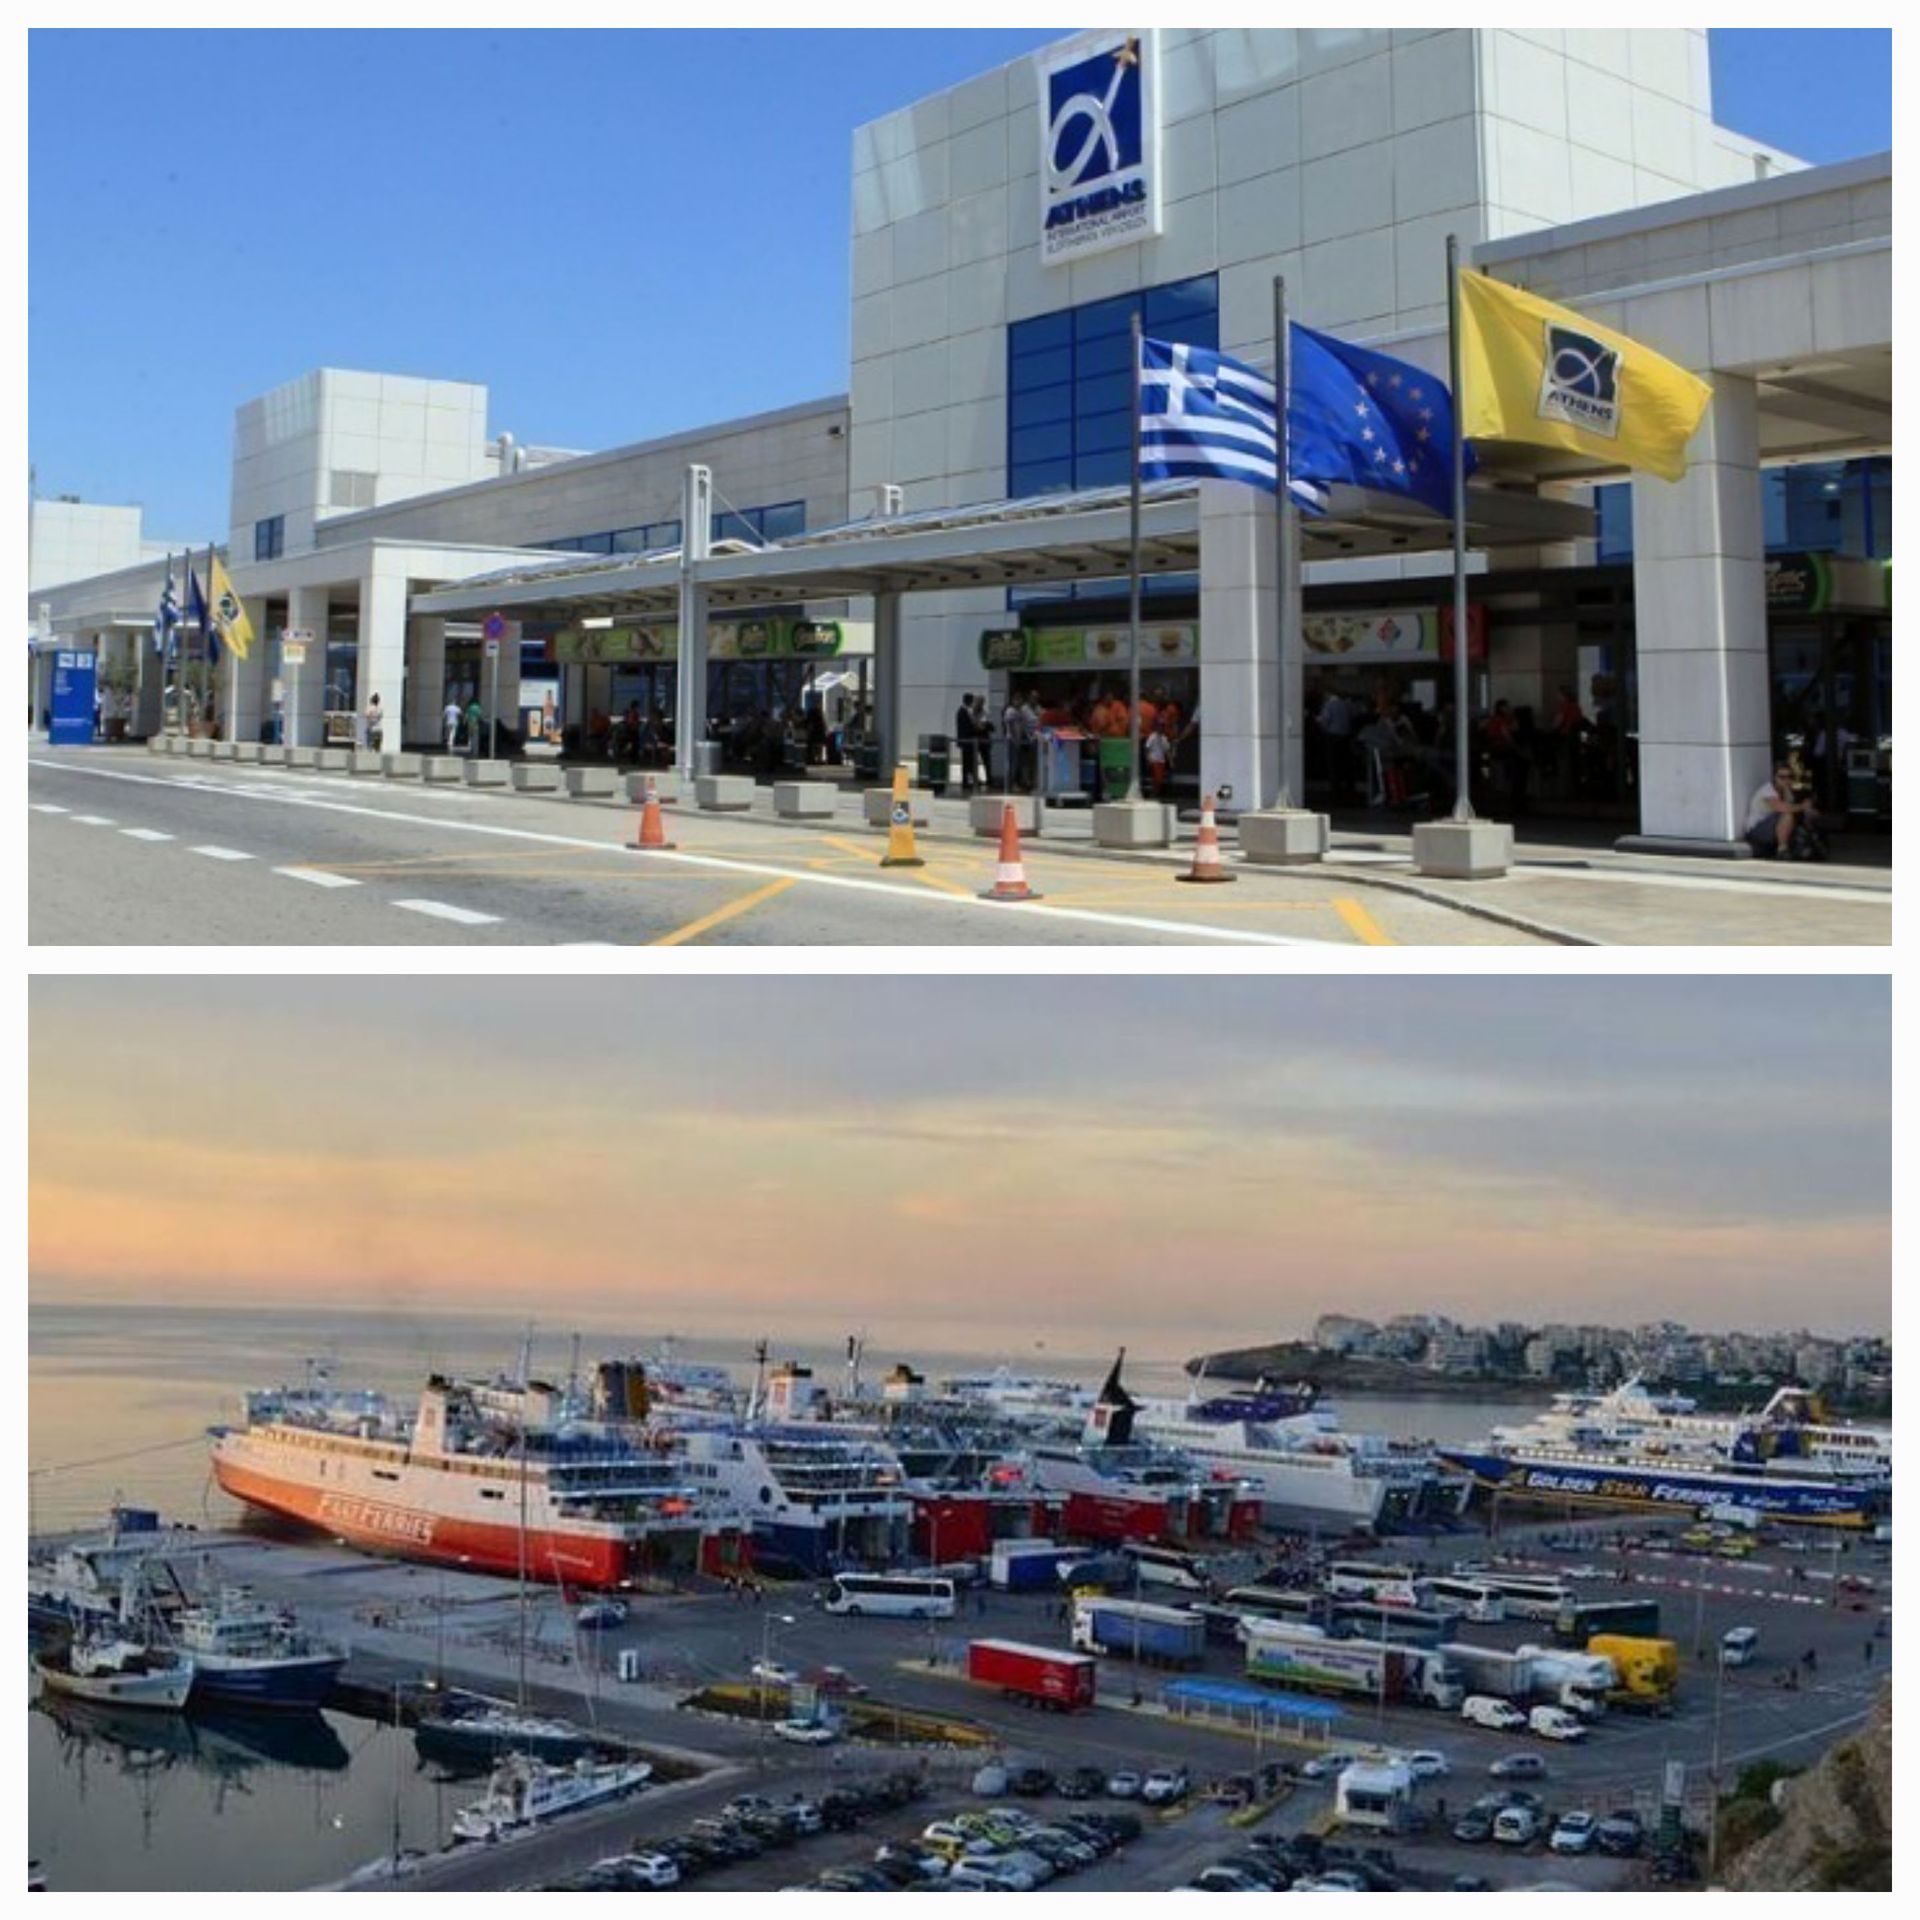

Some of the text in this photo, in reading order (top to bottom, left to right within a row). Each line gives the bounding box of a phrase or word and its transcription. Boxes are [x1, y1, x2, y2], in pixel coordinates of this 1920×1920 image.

[1045, 178, 1147, 230] ATHENS
[1547, 390, 1612, 420] ATHENS
[1527, 1471, 1598, 1492] GOLDEN
